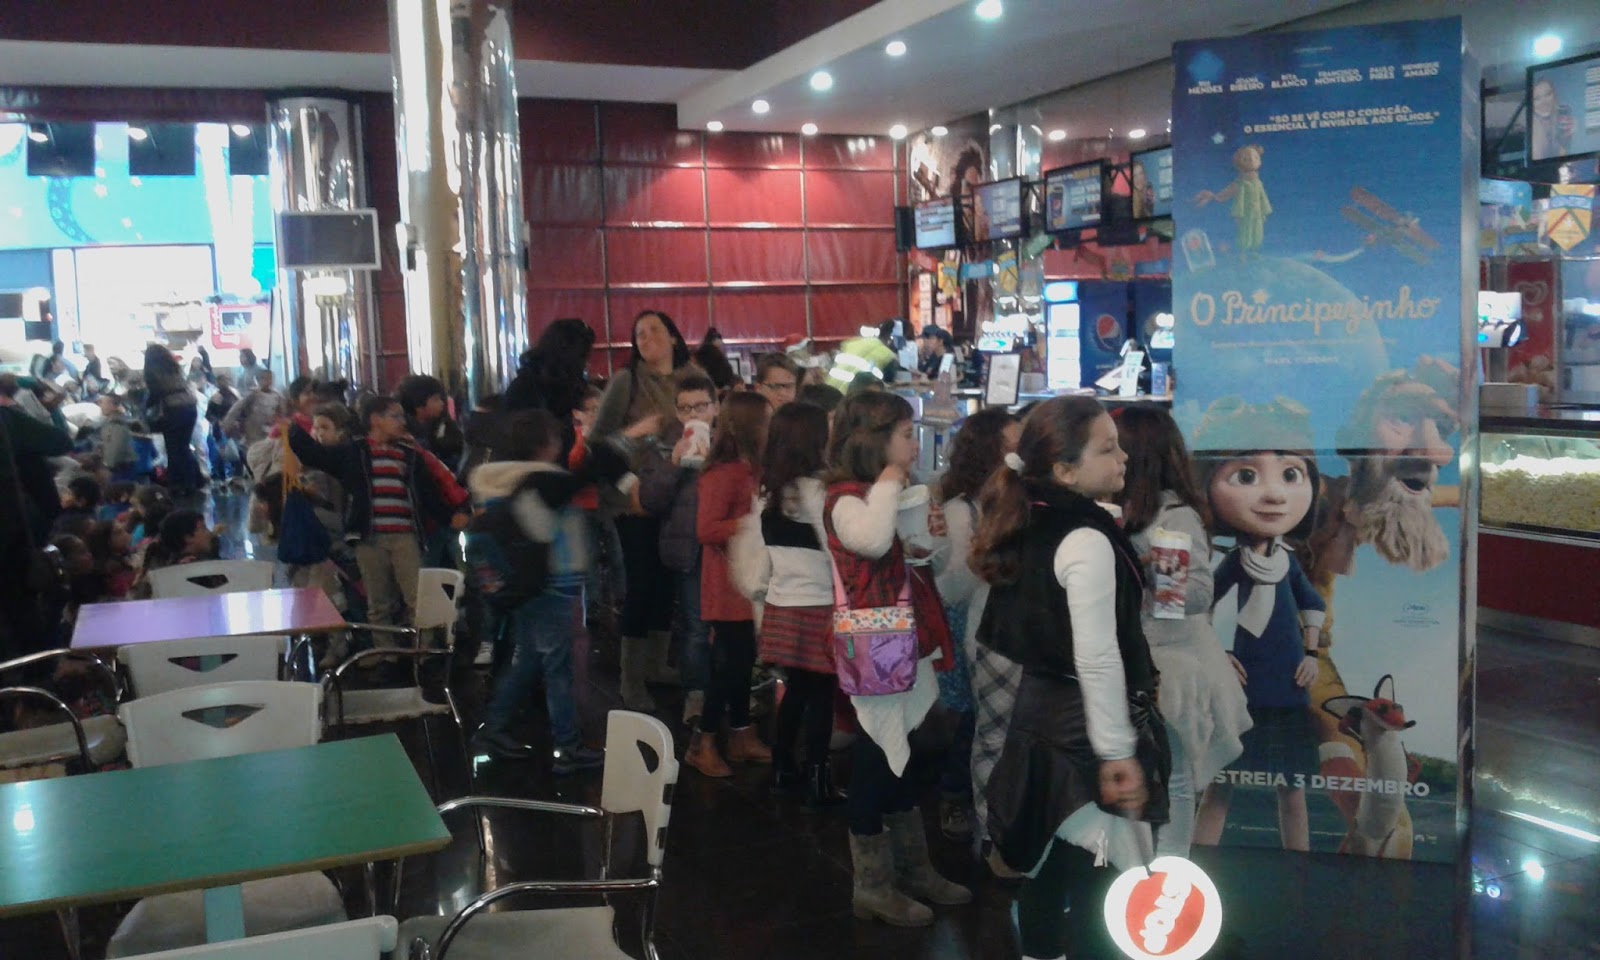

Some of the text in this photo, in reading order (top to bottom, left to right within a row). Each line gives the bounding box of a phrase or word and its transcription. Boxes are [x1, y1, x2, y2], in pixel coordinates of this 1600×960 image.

[1404, 68, 1438, 77] AMARO
[1271, 79, 1308, 88] BLANCO
[1315, 75, 1363, 85] MONTEIRO
[1188, 85, 1223, 95] MENDES
[1230, 82, 1264, 92] RIBEIRO
[1322, 111, 1345, 119] COM
[1347, 110, 1356, 118] O
[1244, 125, 1252, 134] O
[1254, 121, 1309, 133] ESSENCIAL
[1371, 115, 1393, 125] AOS
[1190, 285, 1441, 335] O Principezinho
[1214, 769, 1430, 797] STREIA 3 DEZEMBRO
